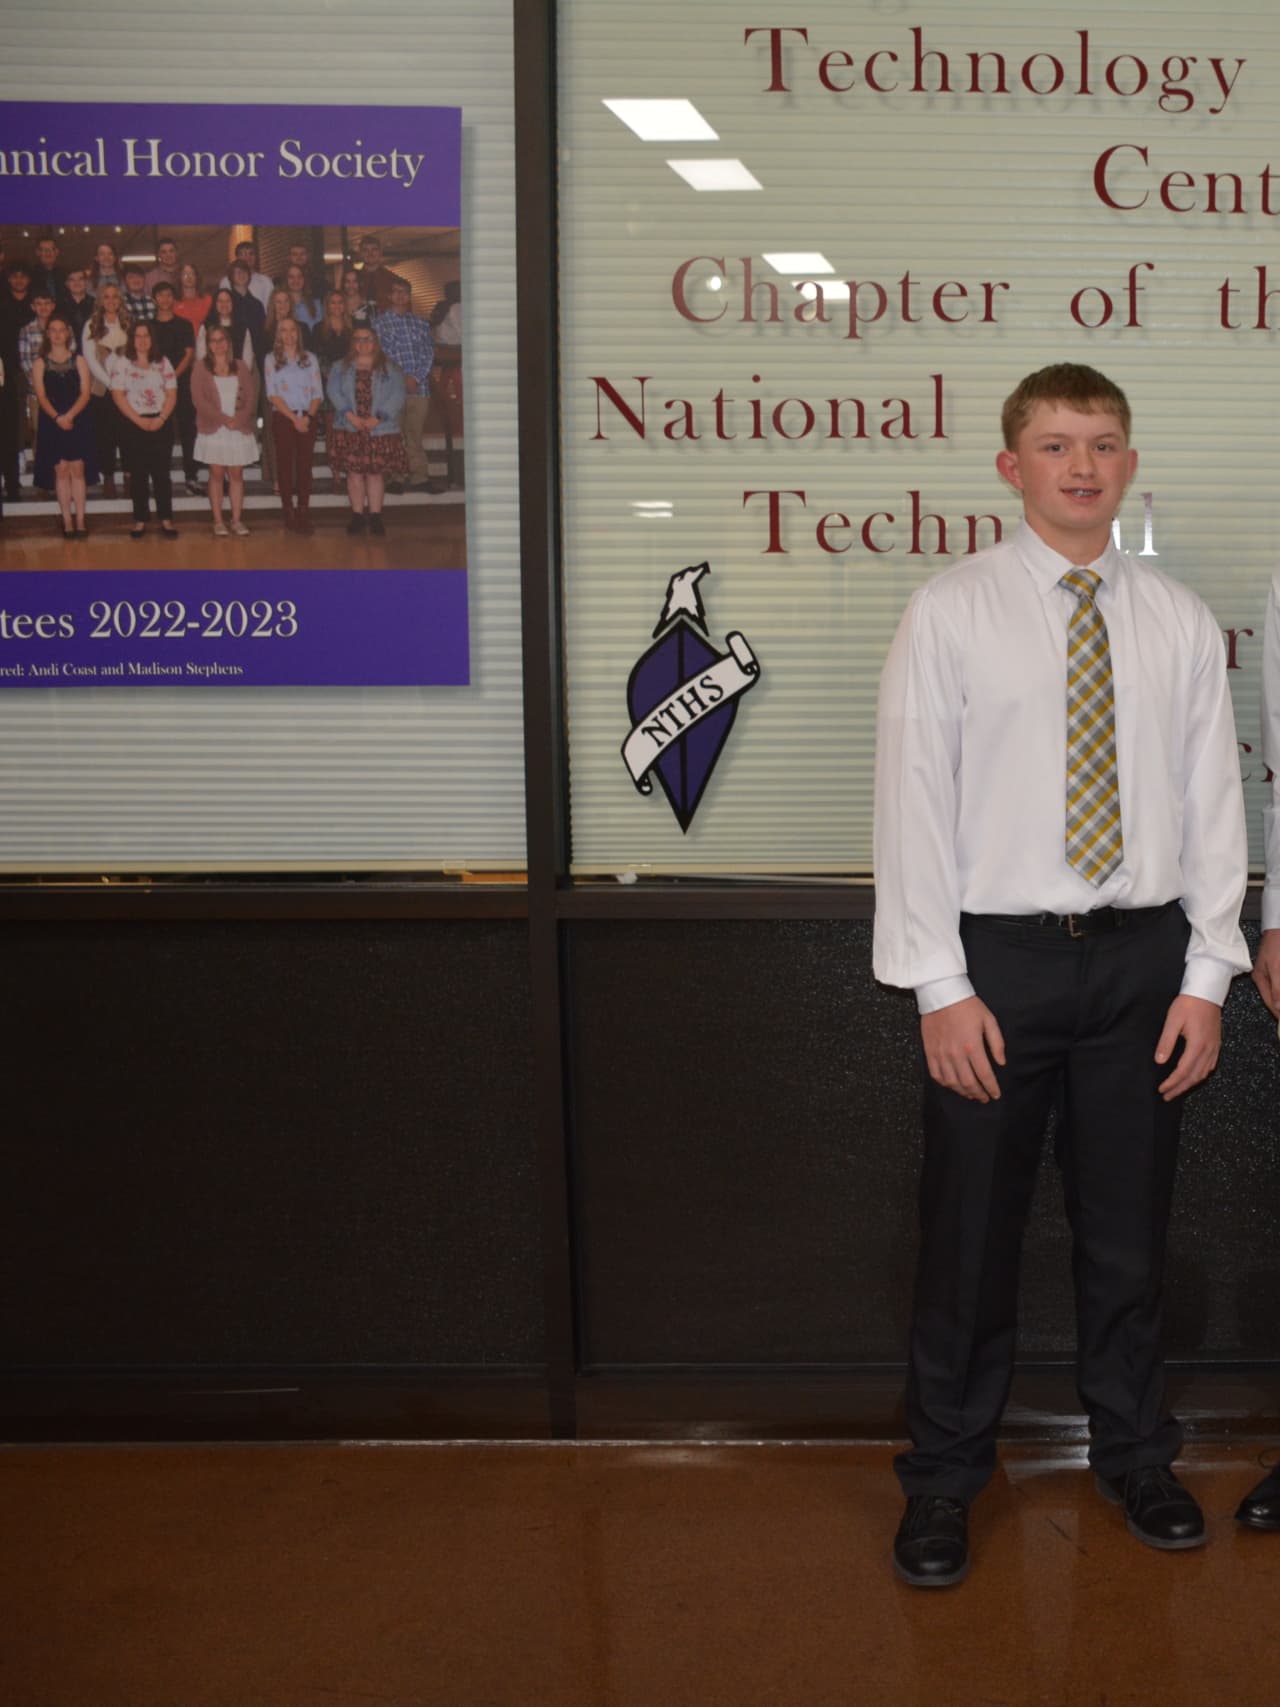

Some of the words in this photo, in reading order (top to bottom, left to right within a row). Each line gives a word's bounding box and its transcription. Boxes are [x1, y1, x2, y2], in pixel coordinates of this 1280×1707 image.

[744, 27, 1247, 114] Technology
[123, 138, 264, 177] Honor
[278, 139, 425, 188] Society
[671, 256, 1010, 340] Chapter
[1070, 262, 1155, 328] of
[587, 374, 949, 442] National
[743, 490, 1160, 556] Technl
[89, 600, 298, 638] 2022-2023
[28, 663, 59, 677] Andi
[101, 662, 124, 676] and
[128, 662, 182, 676] Madison
[186, 661, 244, 678] Stephens
[640, 674, 725, 748] NTHS
